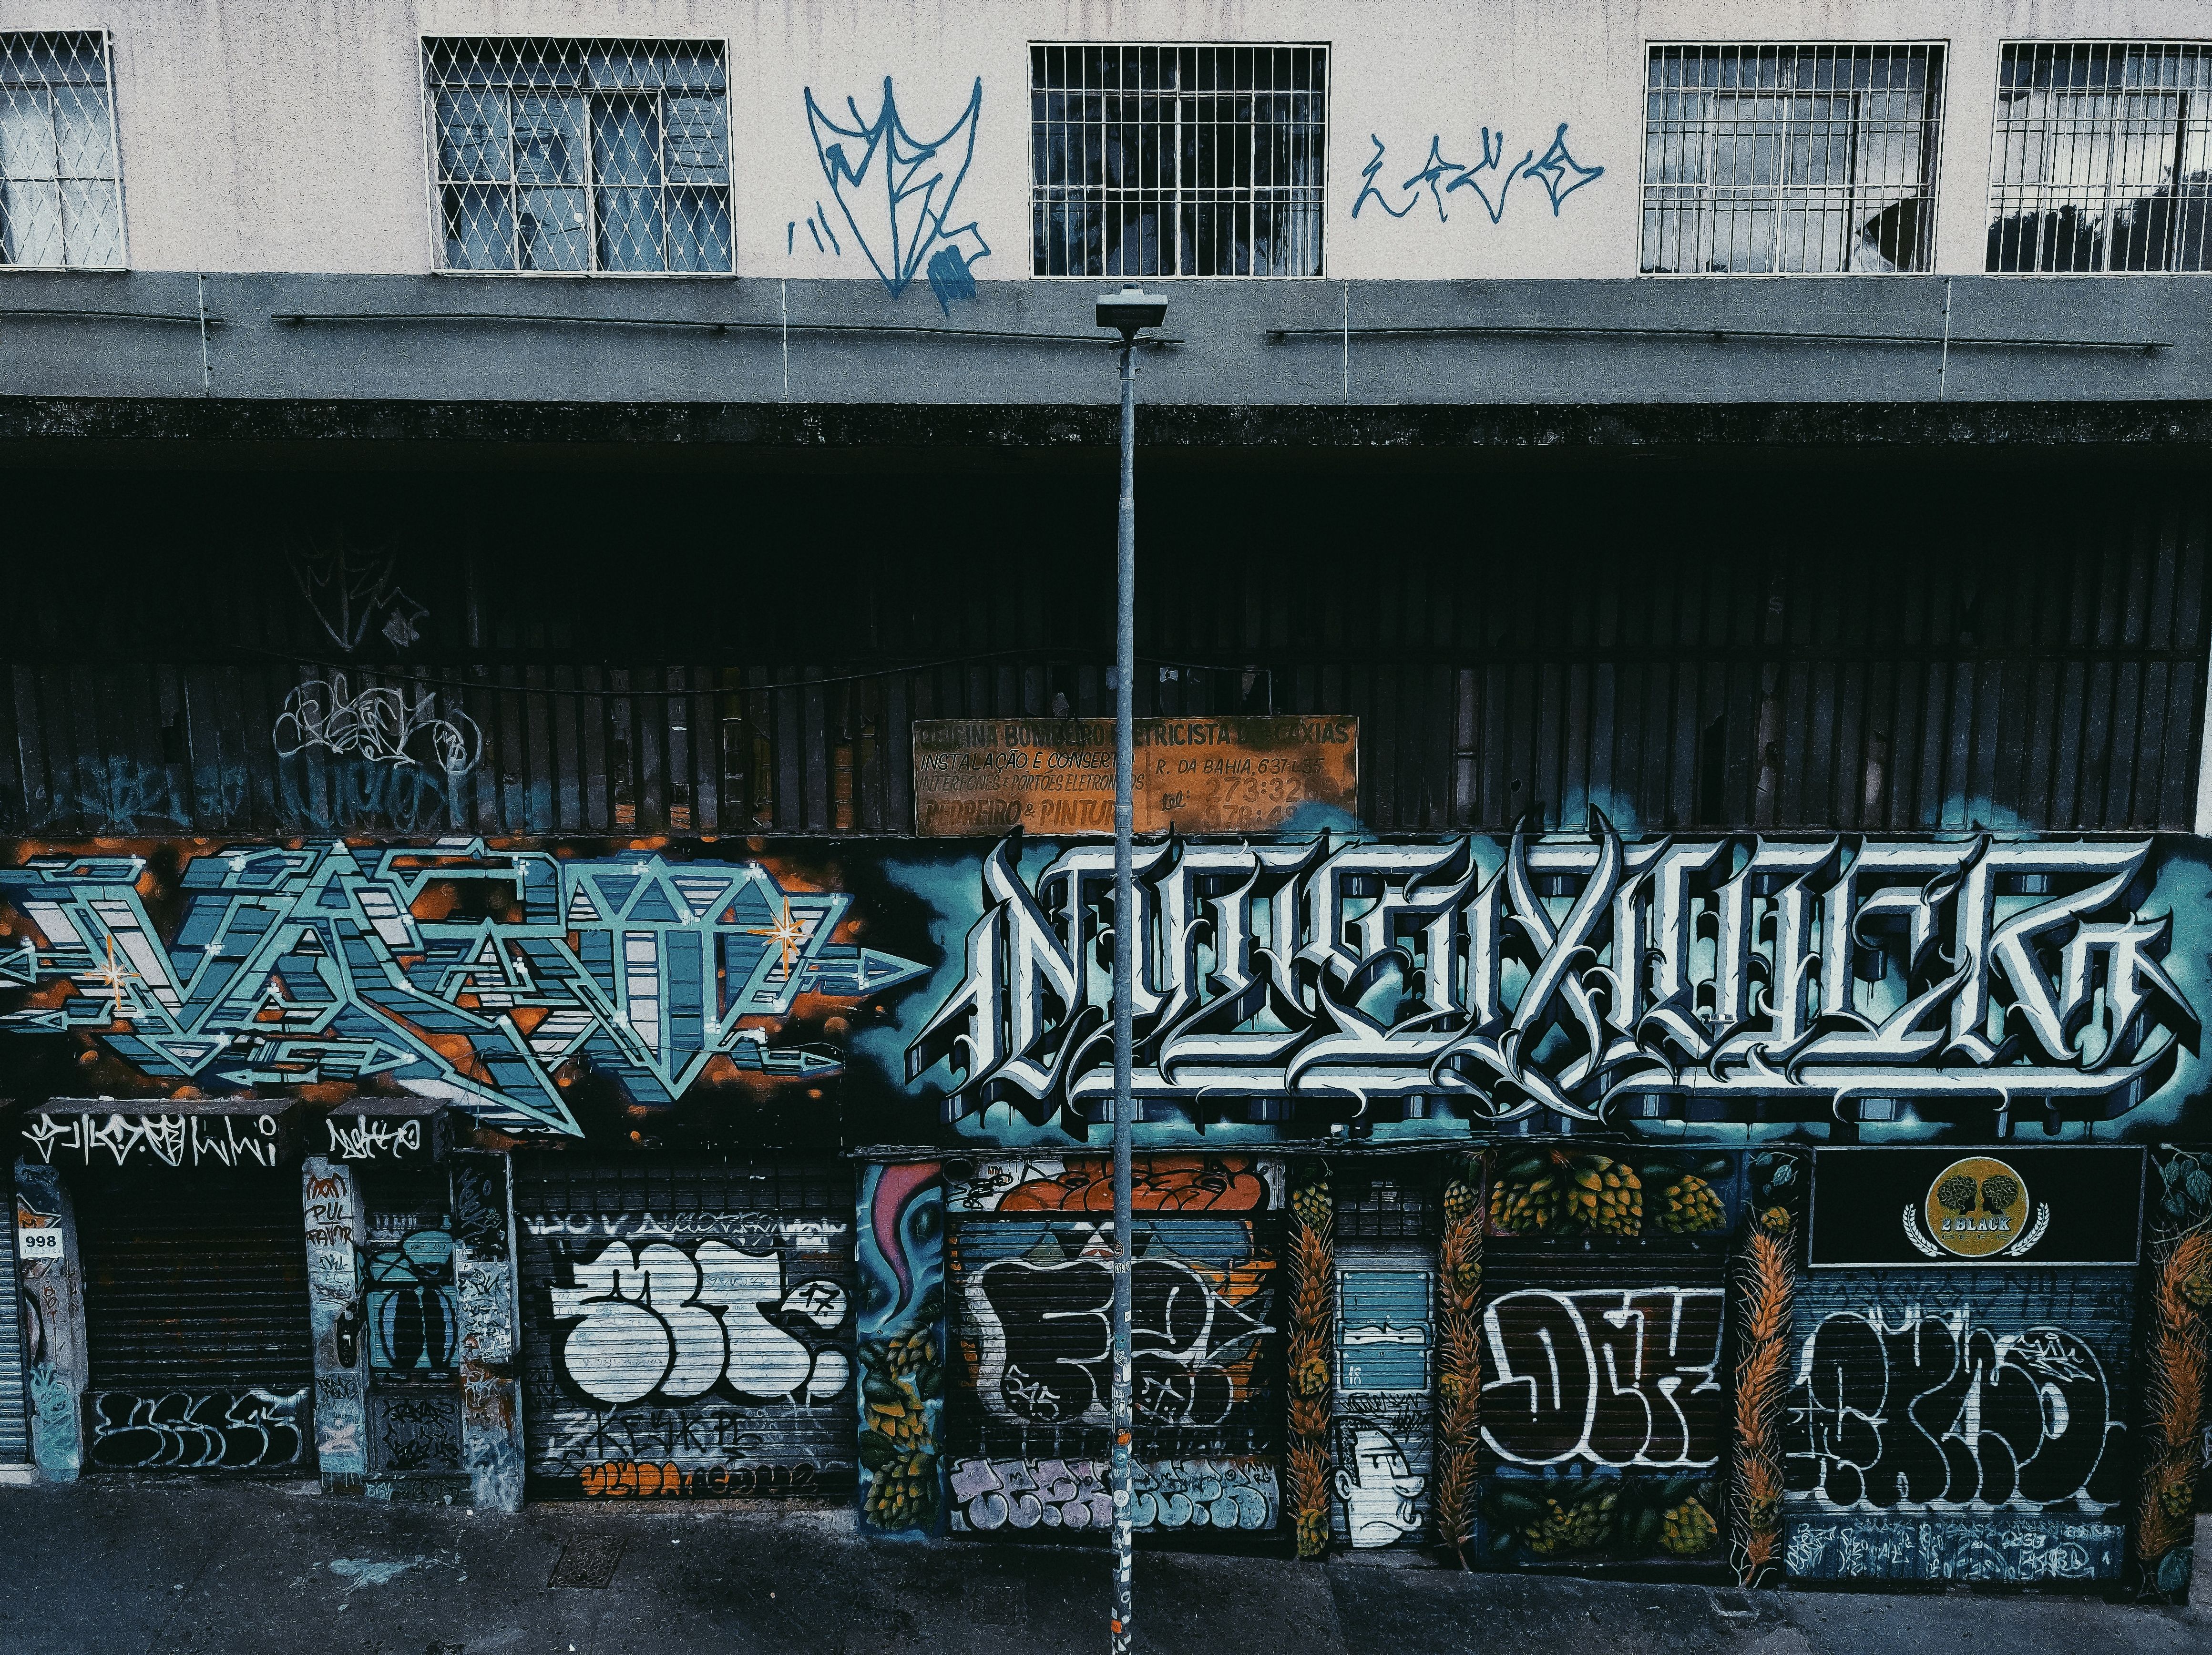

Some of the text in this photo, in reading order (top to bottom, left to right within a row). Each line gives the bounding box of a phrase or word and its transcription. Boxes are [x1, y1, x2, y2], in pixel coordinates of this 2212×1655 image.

[921, 749, 1134, 774] INSTALAÇÃO E CONSERT
[1178, 759, 1196, 774] DA
[1011, 770, 1063, 792] PORTÕES
[1040, 799, 1134, 827] PINTUR
[1941, 1216, 2012, 1232] 2 BLACK
[26, 1236, 56, 1247] 998
